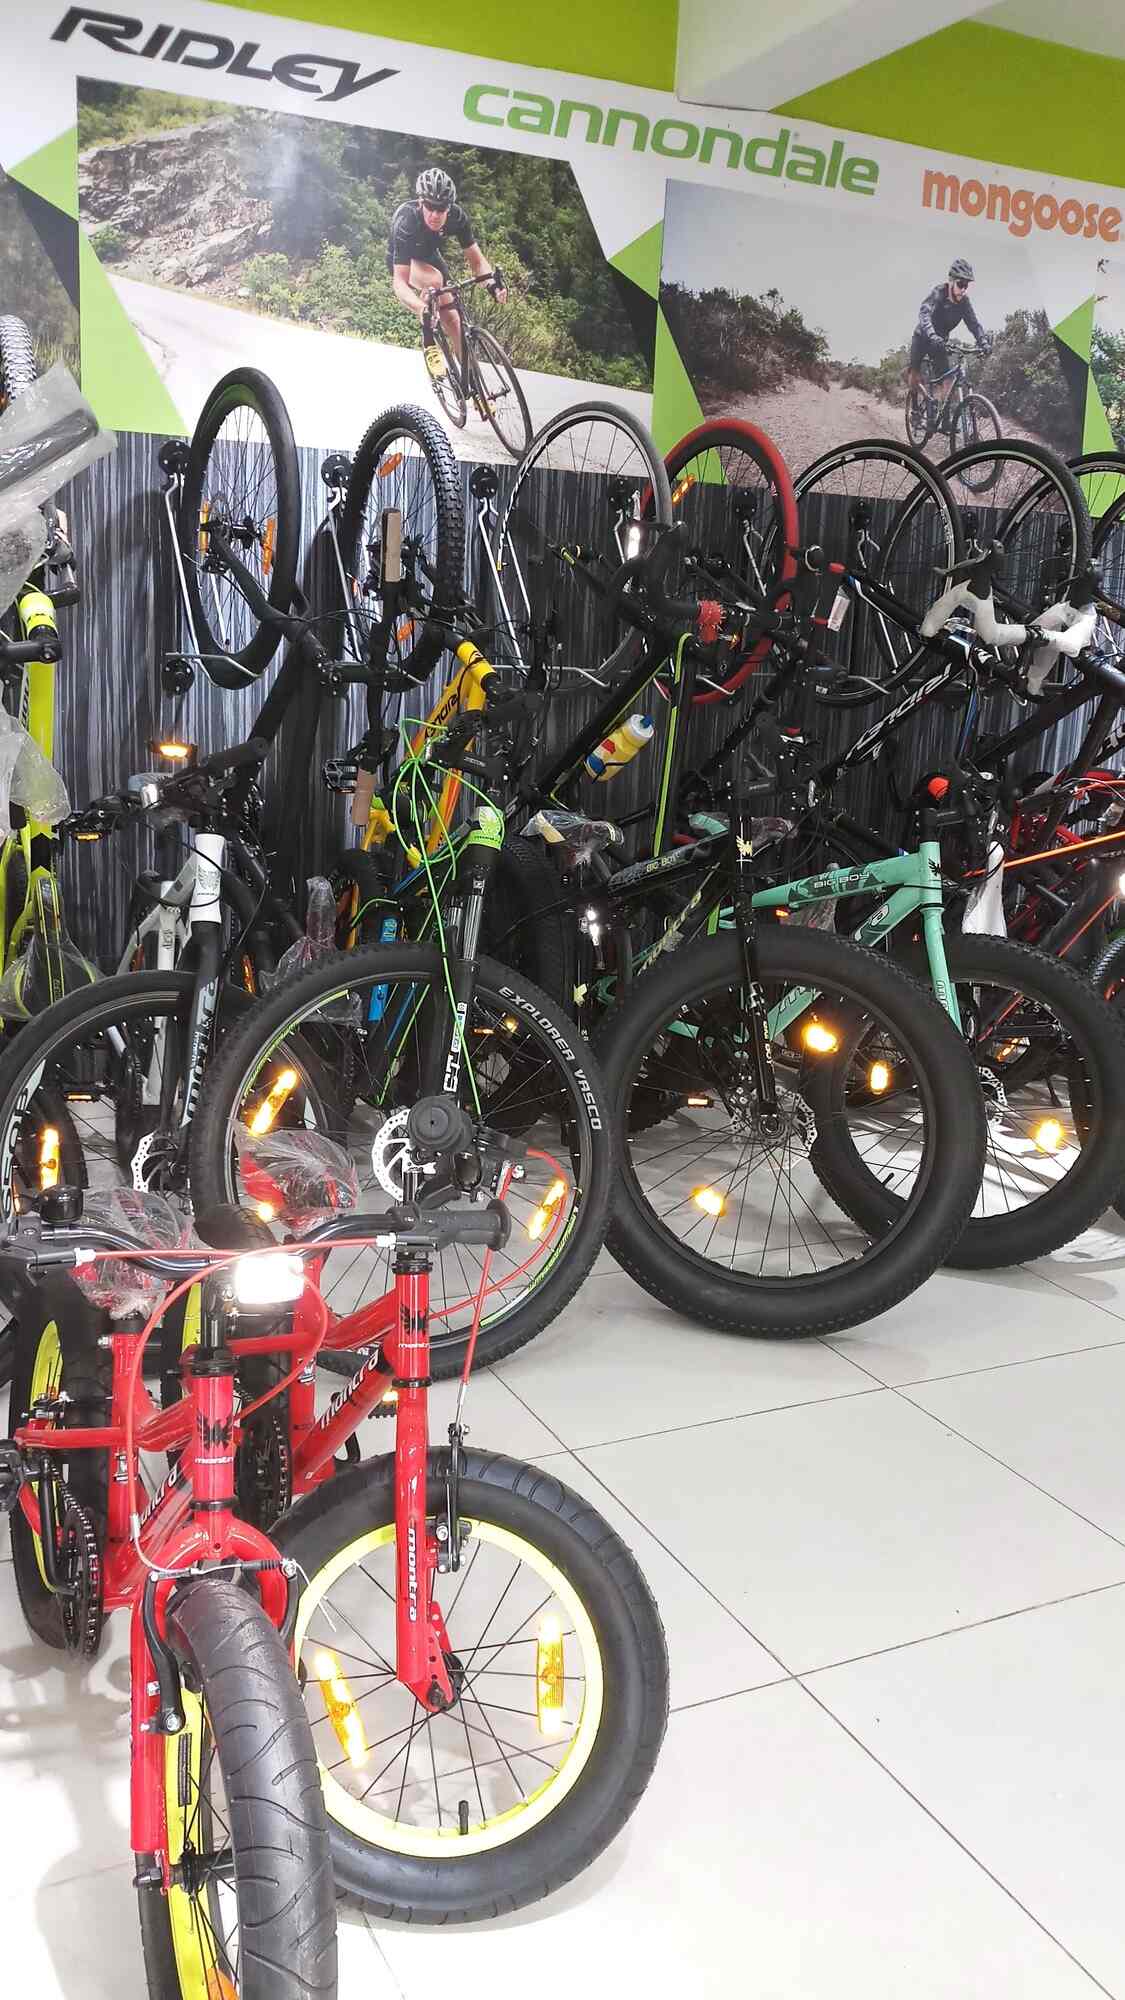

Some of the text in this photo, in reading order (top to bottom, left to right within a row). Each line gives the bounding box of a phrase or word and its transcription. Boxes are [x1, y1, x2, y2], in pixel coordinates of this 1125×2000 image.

[50, 6, 400, 101] RIDLEY
[463, 84, 880, 195] cannondale
[922, 169, 1122, 242] mongoose
[499, 986, 602, 1130] EXPLORER VASCO
[194, 1456, 234, 1464] montr
[408, 1527, 418, 1622] montra
